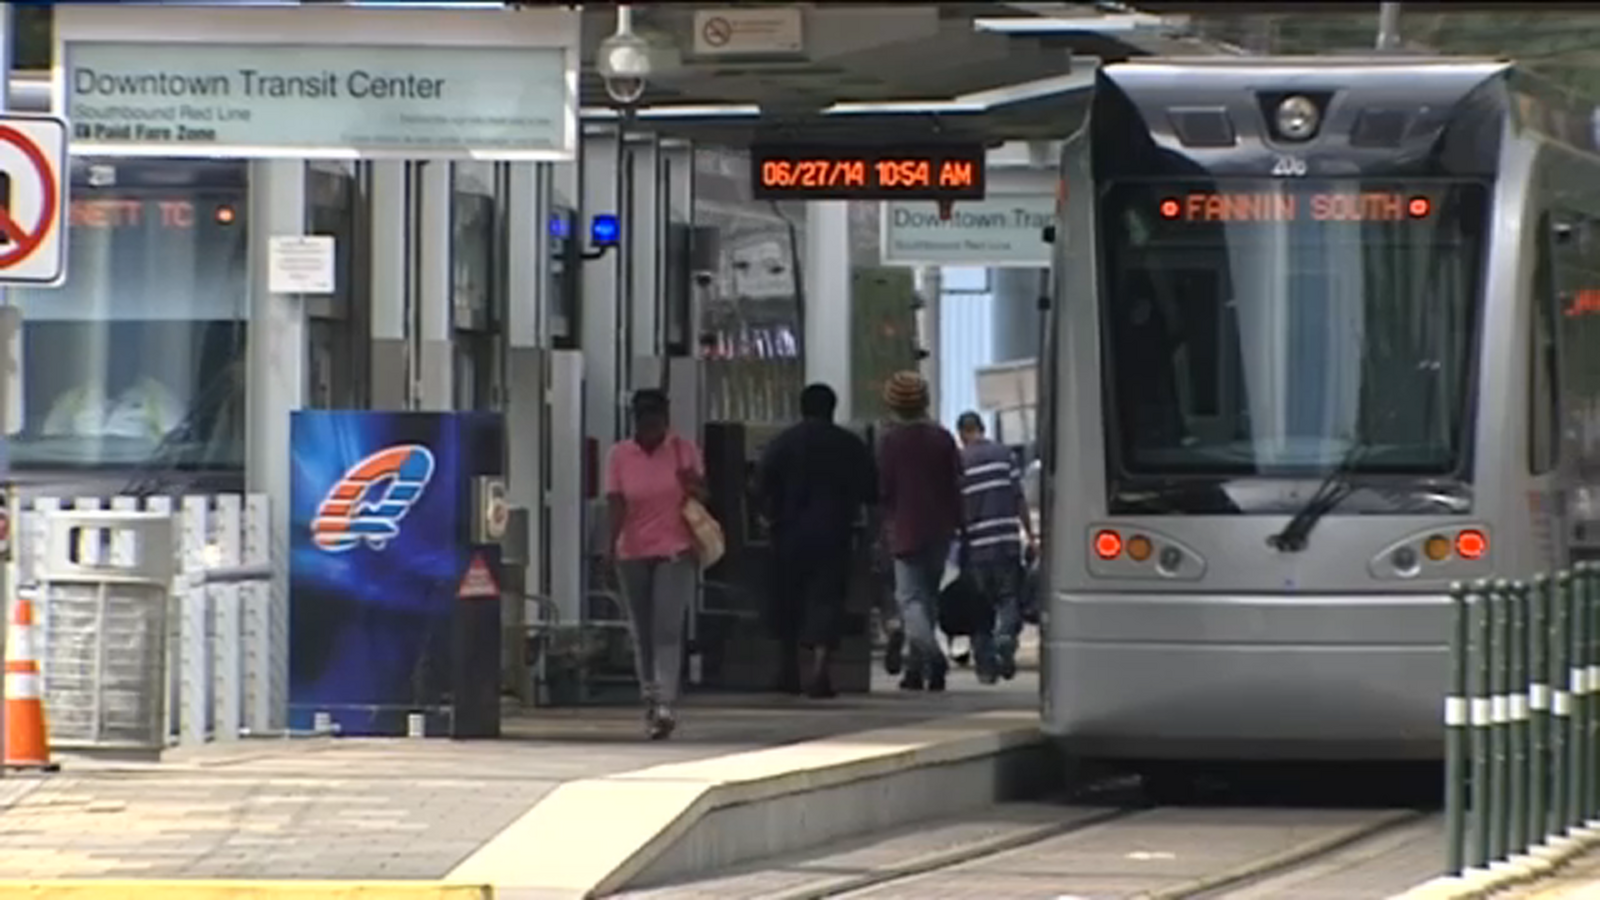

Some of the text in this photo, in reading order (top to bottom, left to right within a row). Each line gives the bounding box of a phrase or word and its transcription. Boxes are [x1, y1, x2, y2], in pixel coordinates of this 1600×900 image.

[75, 68, 445, 98] Downtown Transit Center
[75, 104, 251, 122] Southbound Red Line
[95, 123, 216, 141] Paid Fare Zone
[763, 161, 973, 186] 06/27/14 10:54 AM
[1187, 194, 1403, 221] FANNIN SOUTH
